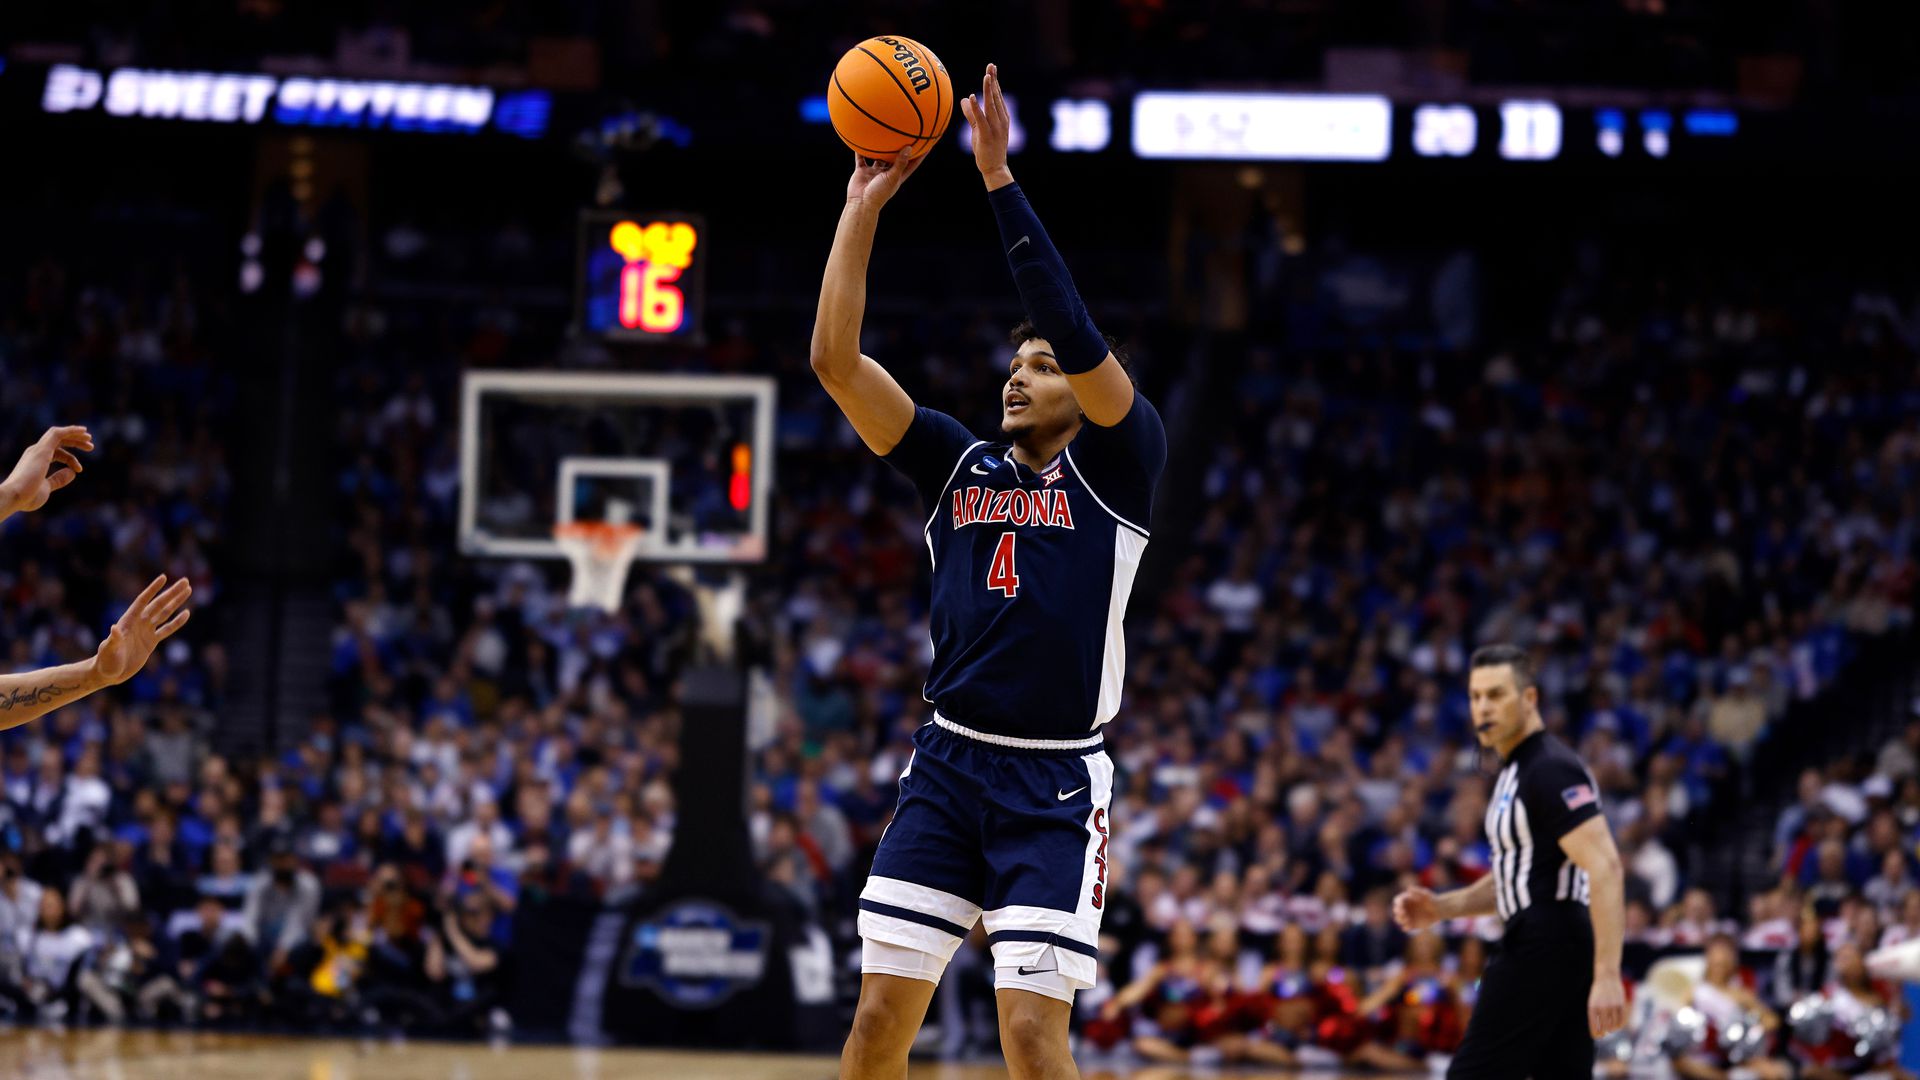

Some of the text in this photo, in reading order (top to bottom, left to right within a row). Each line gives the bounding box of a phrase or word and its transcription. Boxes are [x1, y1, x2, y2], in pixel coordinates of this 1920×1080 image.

[103, 67, 276, 123] SWEET
[619, 261, 684, 333] 16
[952, 486, 1075, 530] ARIZONA
[986, 531, 1019, 598] 4
[1091, 807, 1108, 910] CATS
